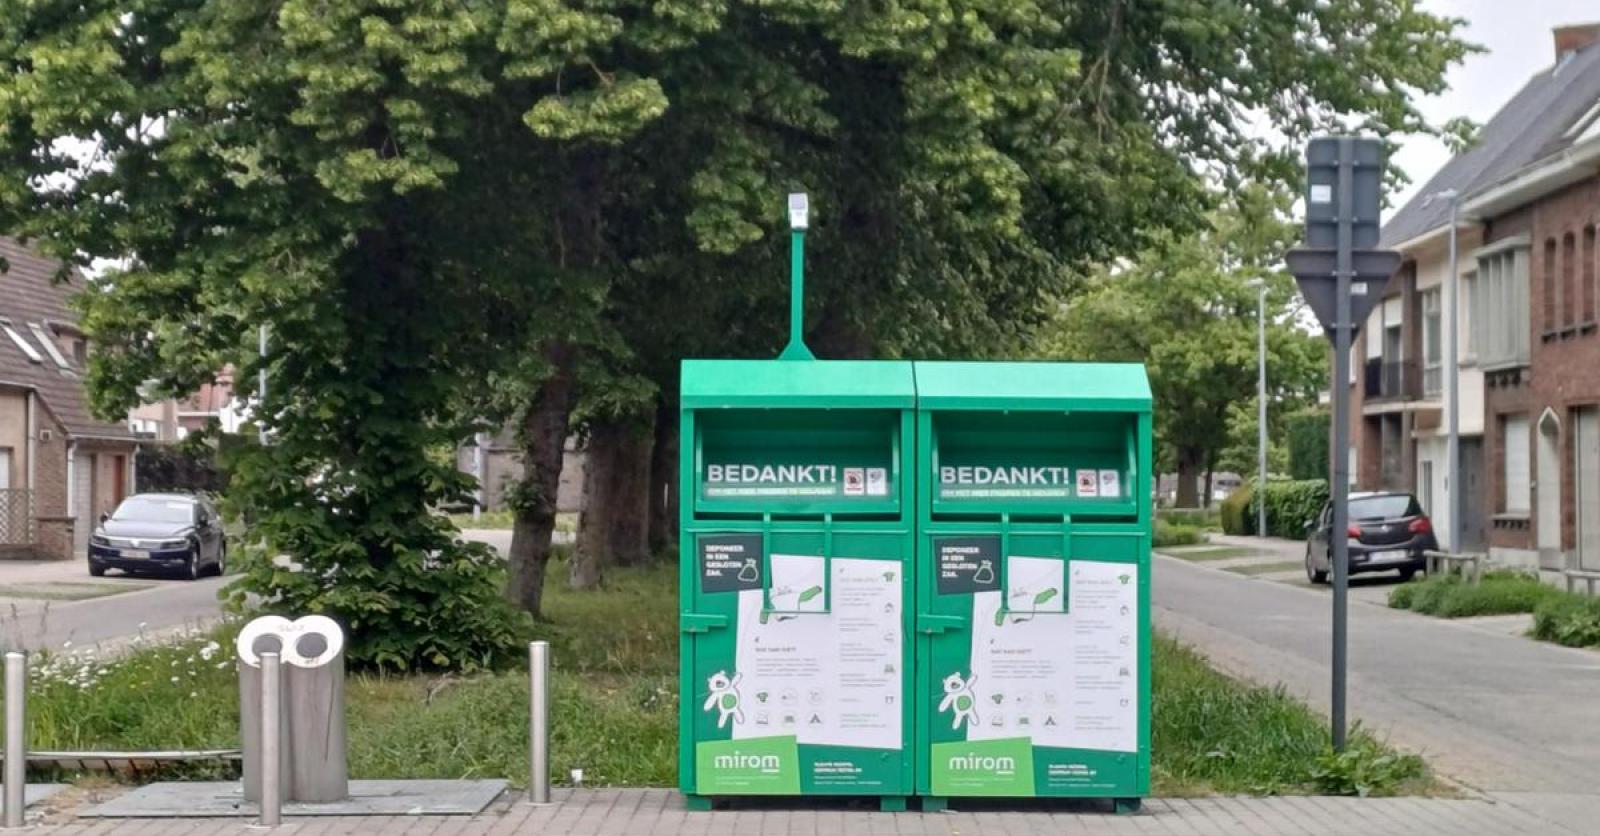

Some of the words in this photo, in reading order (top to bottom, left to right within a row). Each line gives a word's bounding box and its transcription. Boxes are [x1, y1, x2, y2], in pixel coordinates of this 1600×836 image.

[707, 465, 837, 483] BEDANKT!
[940, 467, 1069, 485] BEDANKT!
[714, 751, 780, 769] mirom
[949, 752, 1015, 770] mirom
